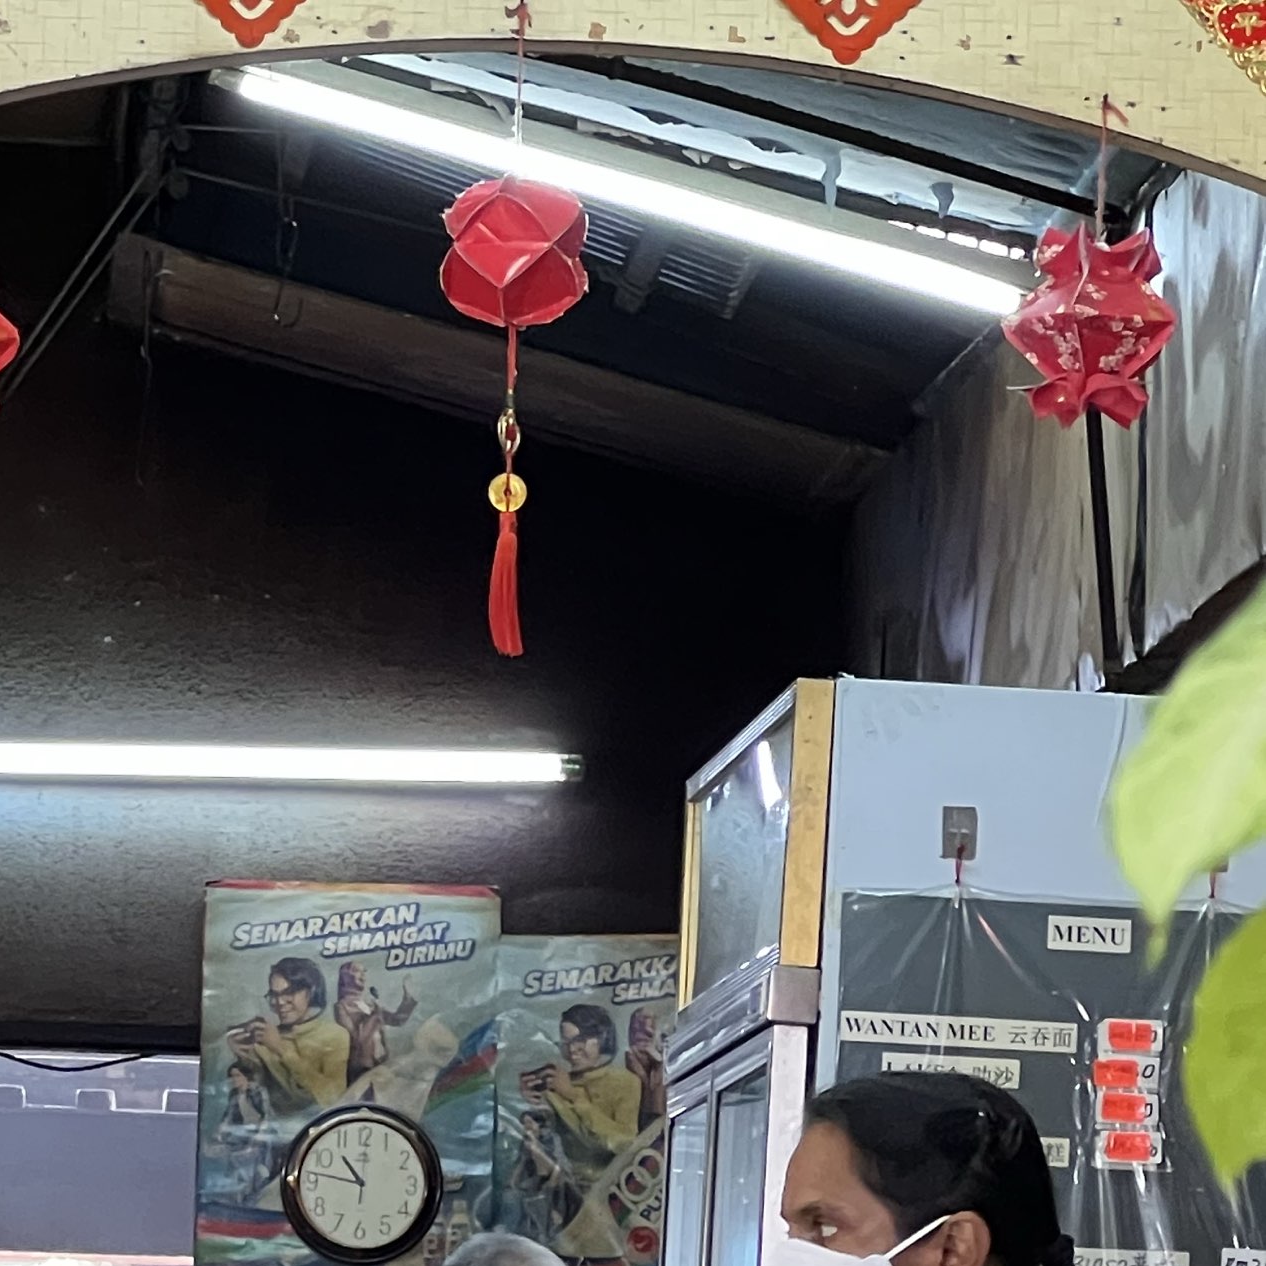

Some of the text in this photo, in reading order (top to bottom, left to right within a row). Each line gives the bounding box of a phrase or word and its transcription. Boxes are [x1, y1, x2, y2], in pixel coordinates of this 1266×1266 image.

[233, 903, 419, 949] SEMARAKKAN
[1051, 924, 1126, 946] MENU
[323, 922, 448, 957] SEMANGAT
[386, 941, 474, 969] DIRIMU
[845, 1016, 1075, 1047] WANTAN MEE 云吞面
[335, 1130, 347, 1148] 11
[358, 1126, 372, 1147] 12
[384, 1132, 389, 1152] 1
[313, 1149, 333, 1168] 10
[399, 1151, 410, 1170] 2
[306, 1172, 318, 1191] 9
[405, 1176, 417, 1196] 3
[313, 1197, 325, 1216] 8
[398, 1200, 410, 1218] 4
[334, 1213, 344, 1233] 7
[354, 1220, 365, 1240] 6
[379, 1215, 391, 1235] 5
